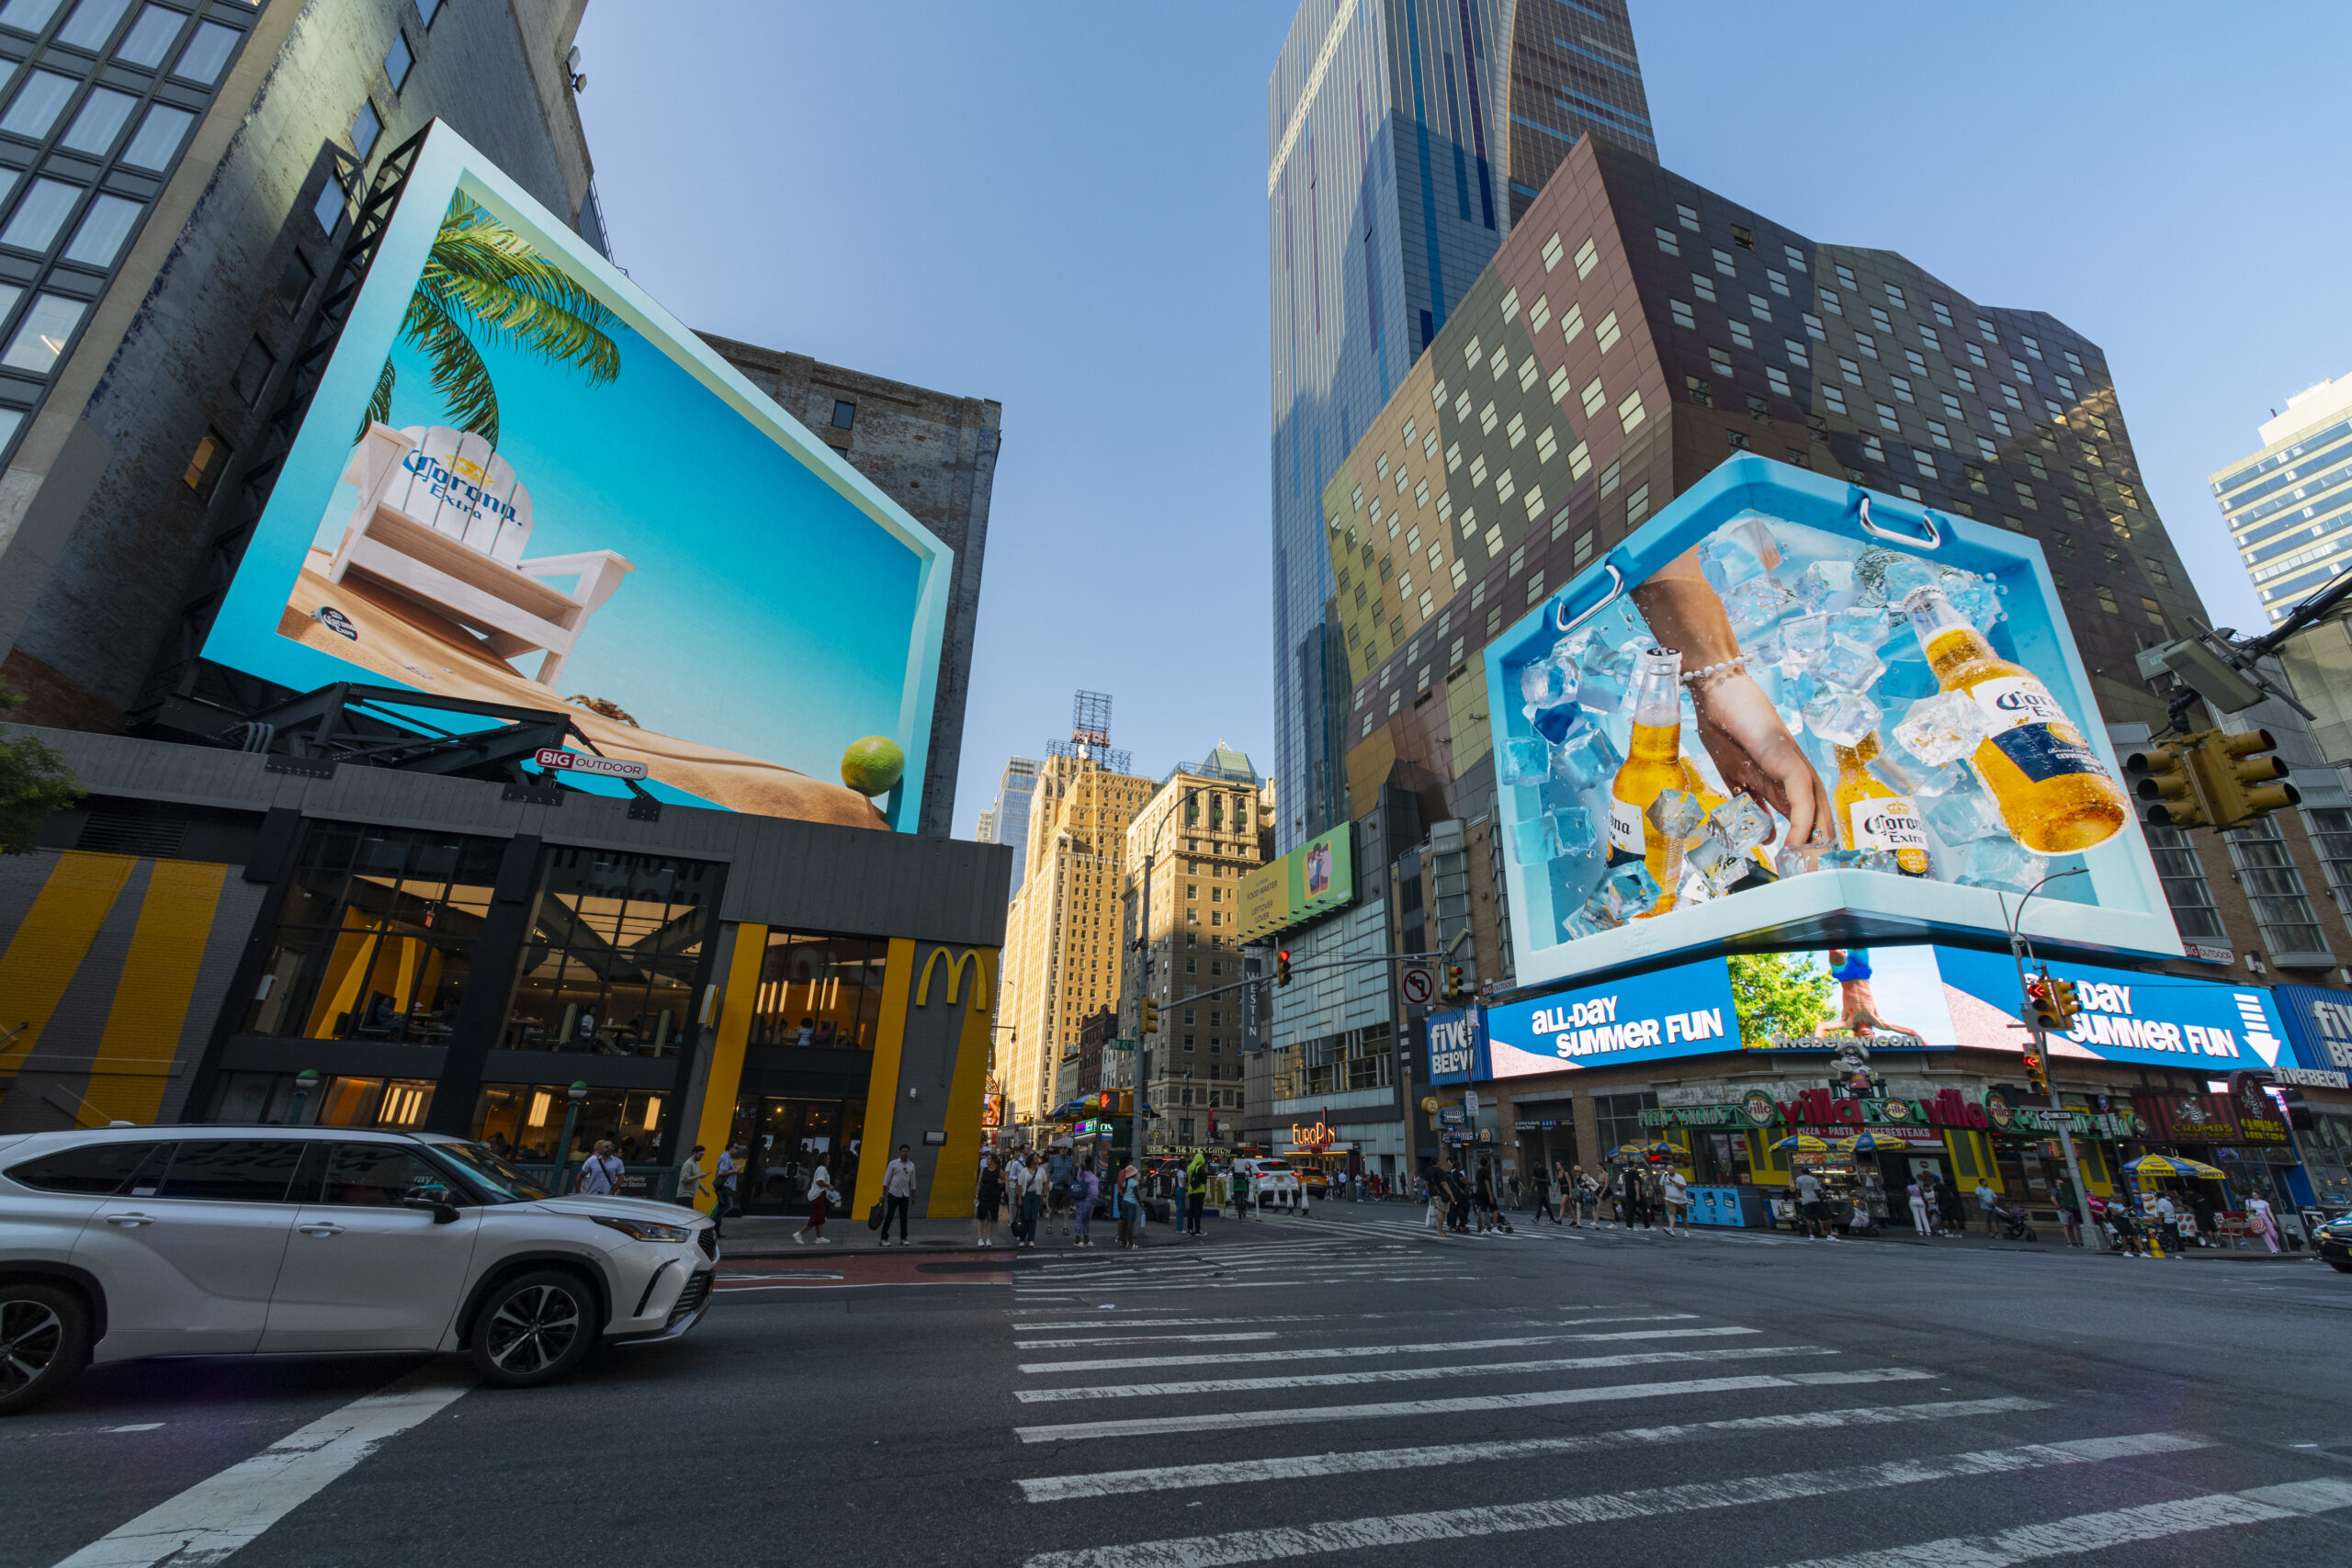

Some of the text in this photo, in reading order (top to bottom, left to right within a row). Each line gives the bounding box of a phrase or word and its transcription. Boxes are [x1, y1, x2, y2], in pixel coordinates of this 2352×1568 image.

[429, 483, 481, 520] Extra
[1073, 728, 1112, 745] HOTEL
[541, 751, 641, 774] BIG OUTDOOR
[1251, 900, 1273, 916] LEFTOVER
[2199, 946, 2233, 960] OUTDOOR
[1482, 986, 1493, 995] BIG
[1247, 972, 1260, 1036] WESTIN
[1774, 1033, 1924, 1048] fivebelow.com
[1745, 1100, 1773, 1115] villa
[1884, 1104, 1910, 1114] villa
[1990, 1103, 2016, 1118] villa
[1797, 1127, 1821, 1135] PIZZA
[1829, 1127, 1855, 1136] PASTA
[2172, 1123, 2234, 1133] CRUMBS
